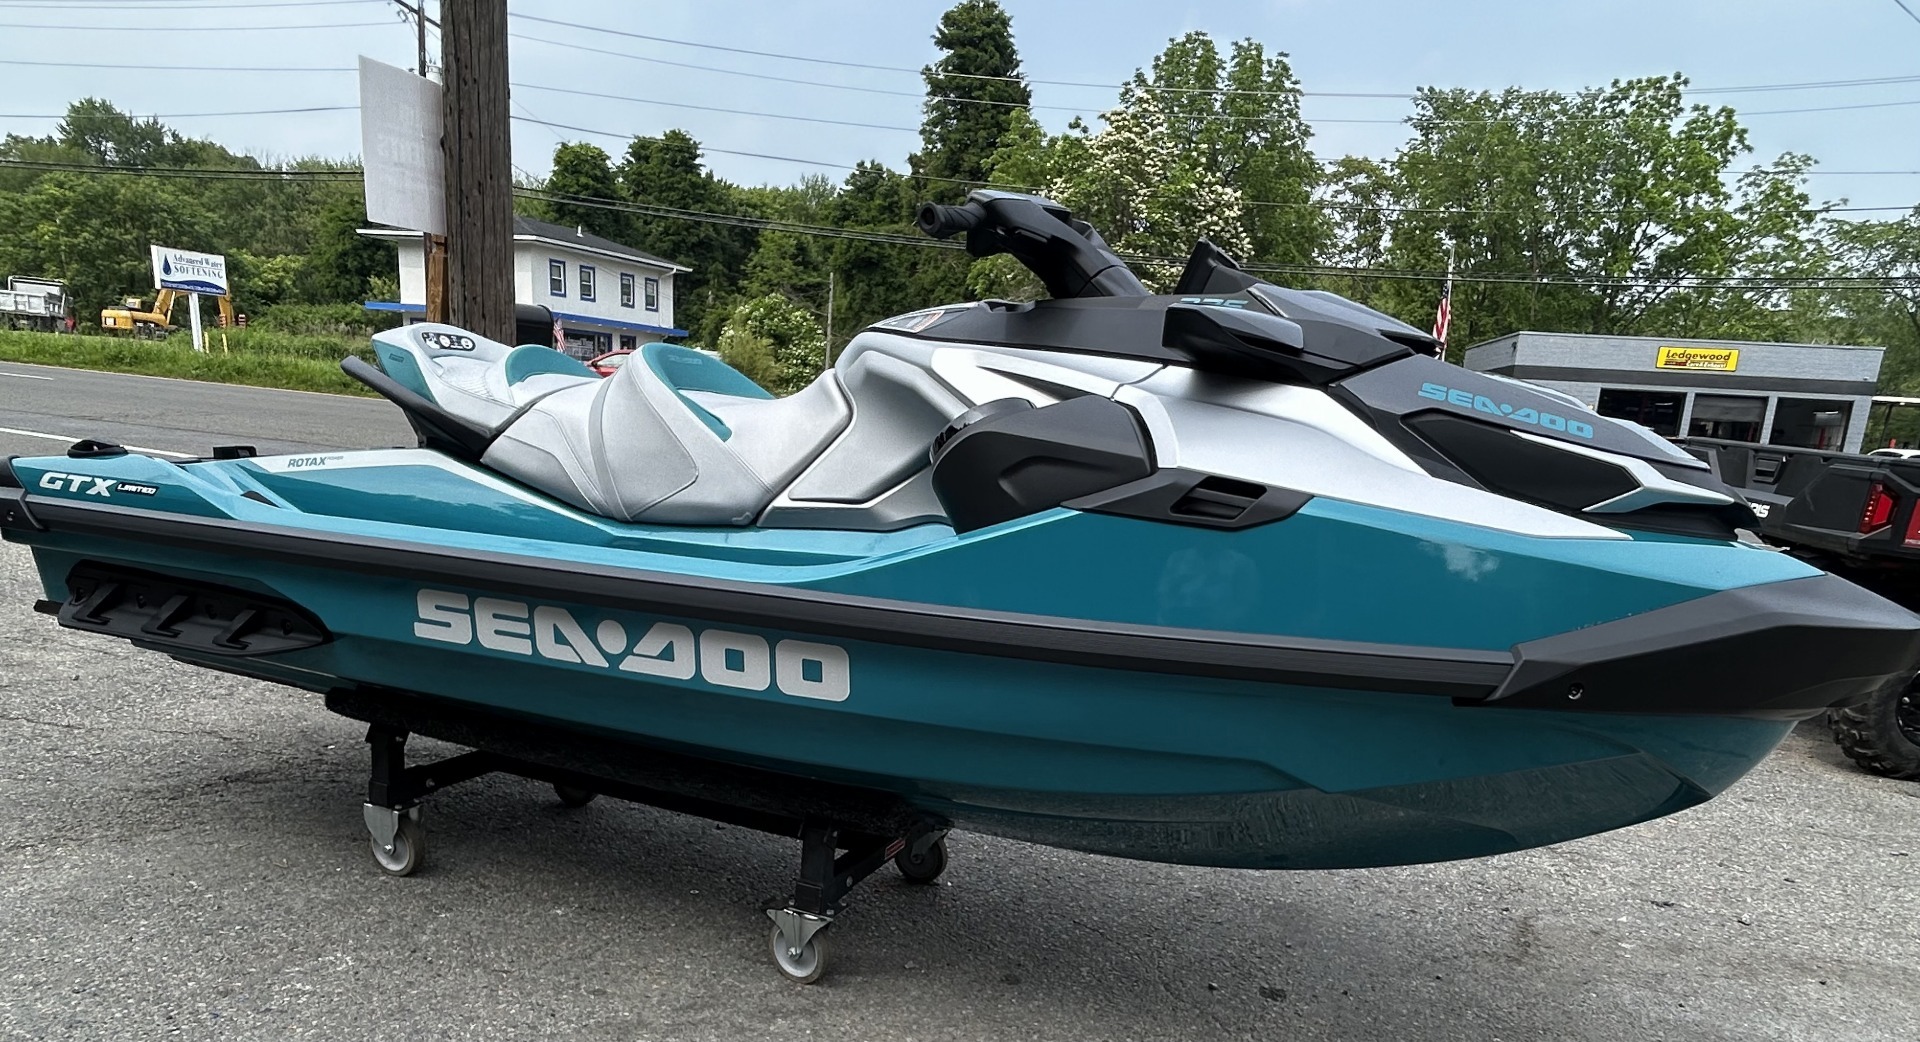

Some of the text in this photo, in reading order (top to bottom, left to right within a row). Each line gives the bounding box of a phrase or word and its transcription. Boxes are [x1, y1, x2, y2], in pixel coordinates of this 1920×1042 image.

[173, 254, 223, 268] Advanced Water
[174, 265, 224, 279] SOFTENING
[1666, 349, 1732, 362] Ledgewood
[287, 456, 327, 468] ROTAX
[39, 471, 157, 497] GTX LIMITED
